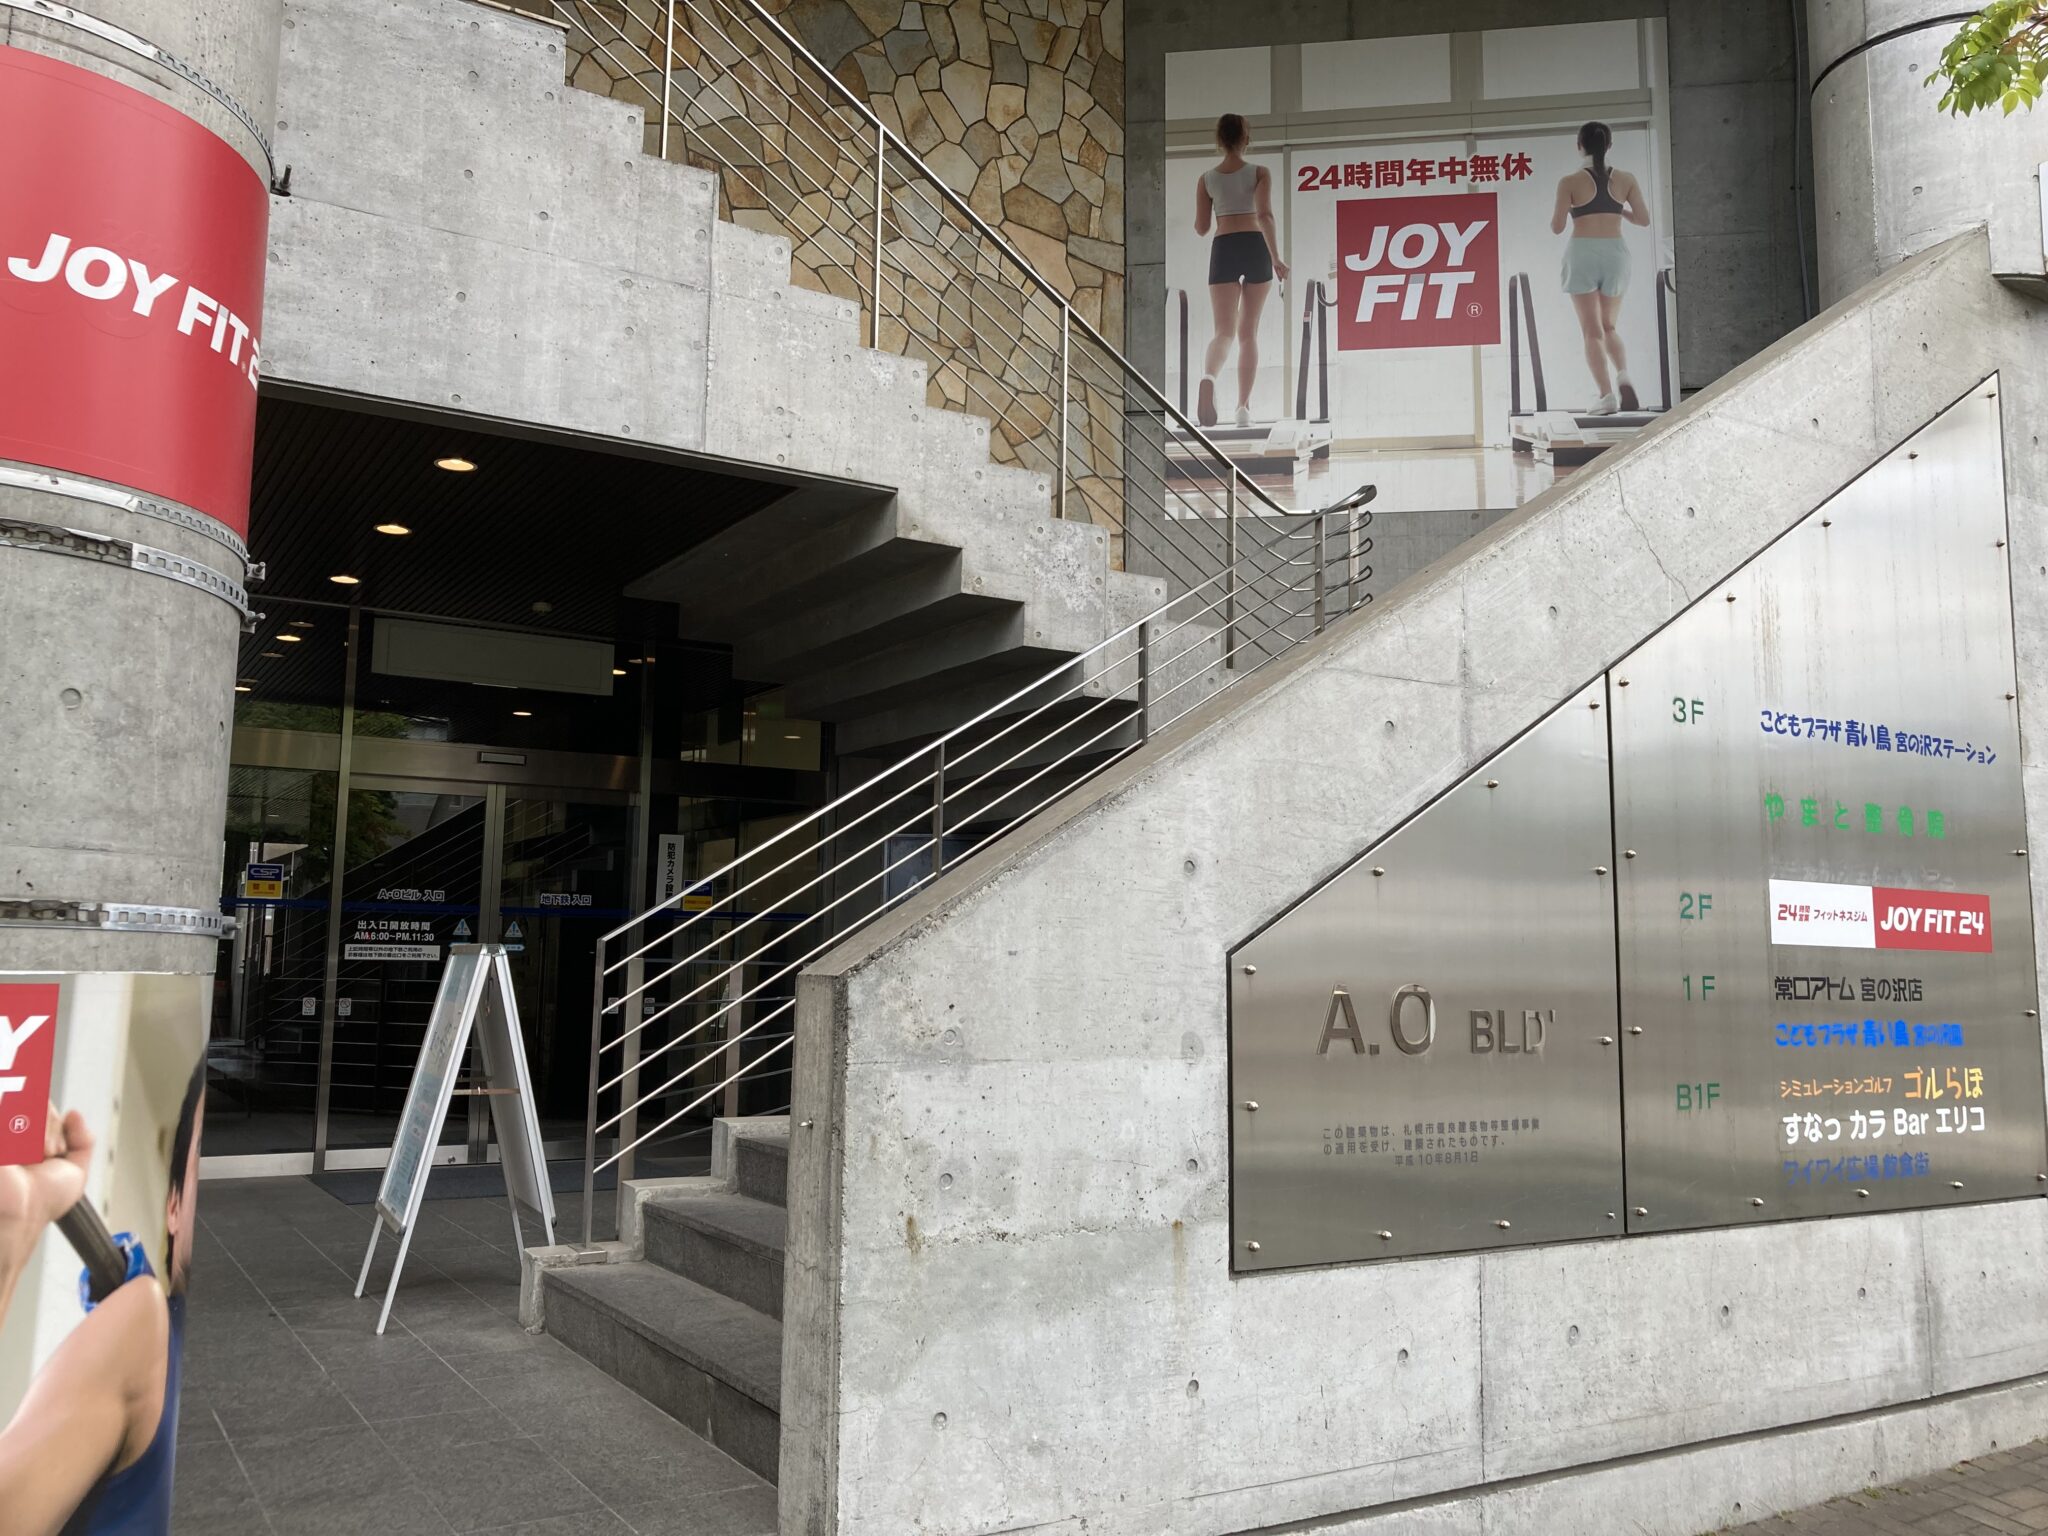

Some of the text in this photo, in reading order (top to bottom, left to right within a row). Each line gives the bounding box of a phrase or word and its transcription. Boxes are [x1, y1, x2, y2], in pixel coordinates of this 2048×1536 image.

[1298, 152, 1533, 192] 24時間年中無休
[1344, 220, 1490, 272] JOY
[7, 232, 180, 317] JOY
[1355, 271, 1475, 322] FIT
[1672, 697, 1705, 725] 3F
[1760, 710, 1997, 765] こどもプラザ 青い鳥 宮の沢ステーション
[423, 889, 445, 902] 入口
[540, 892, 592, 906] 地下鉄 入口
[1679, 893, 1713, 921] 2F
[357, 920, 431, 931] 出入口開放時間
[1813, 909, 1868, 923] フィットネスジム
[1682, 976, 1716, 1001] 1F
[1774, 976, 1923, 1002] 常口アトム 宮の沢店
[1676, 1083, 1721, 1111] B1F
[1780, 1076, 1893, 1098] シミュレーションゴルフ
[1782, 1106, 1986, 1144] すなっ カラ Bar エリコ
